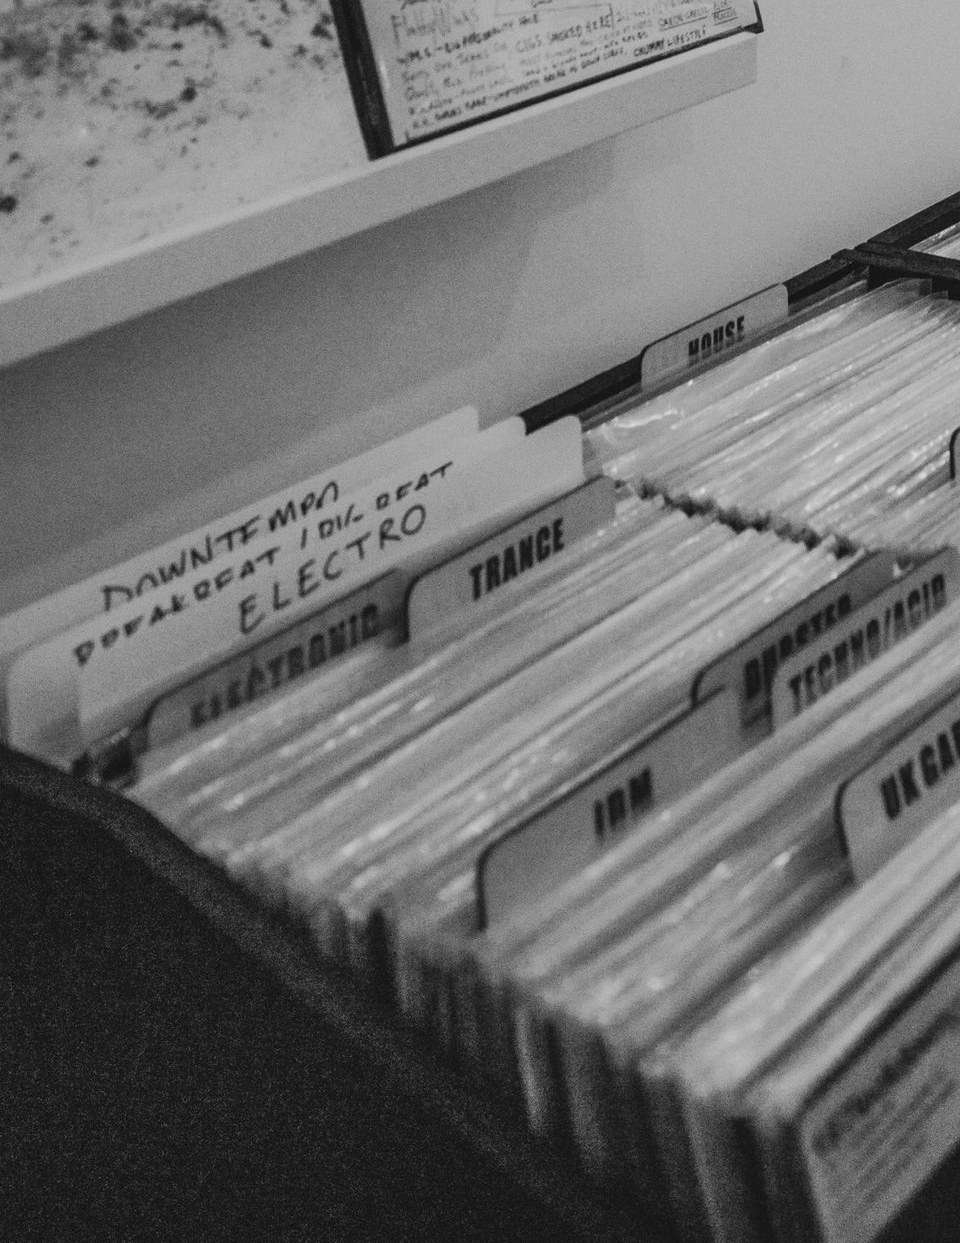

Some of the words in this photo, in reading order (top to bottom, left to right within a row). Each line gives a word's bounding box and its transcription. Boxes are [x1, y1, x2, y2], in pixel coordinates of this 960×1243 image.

[688, 315, 745, 367] HOUSE
[238, 503, 428, 635] ELECTRO
[469, 517, 565, 602] TRANCE
[593, 765, 654, 843] IDM
[879, 760, 922, 822] UK
